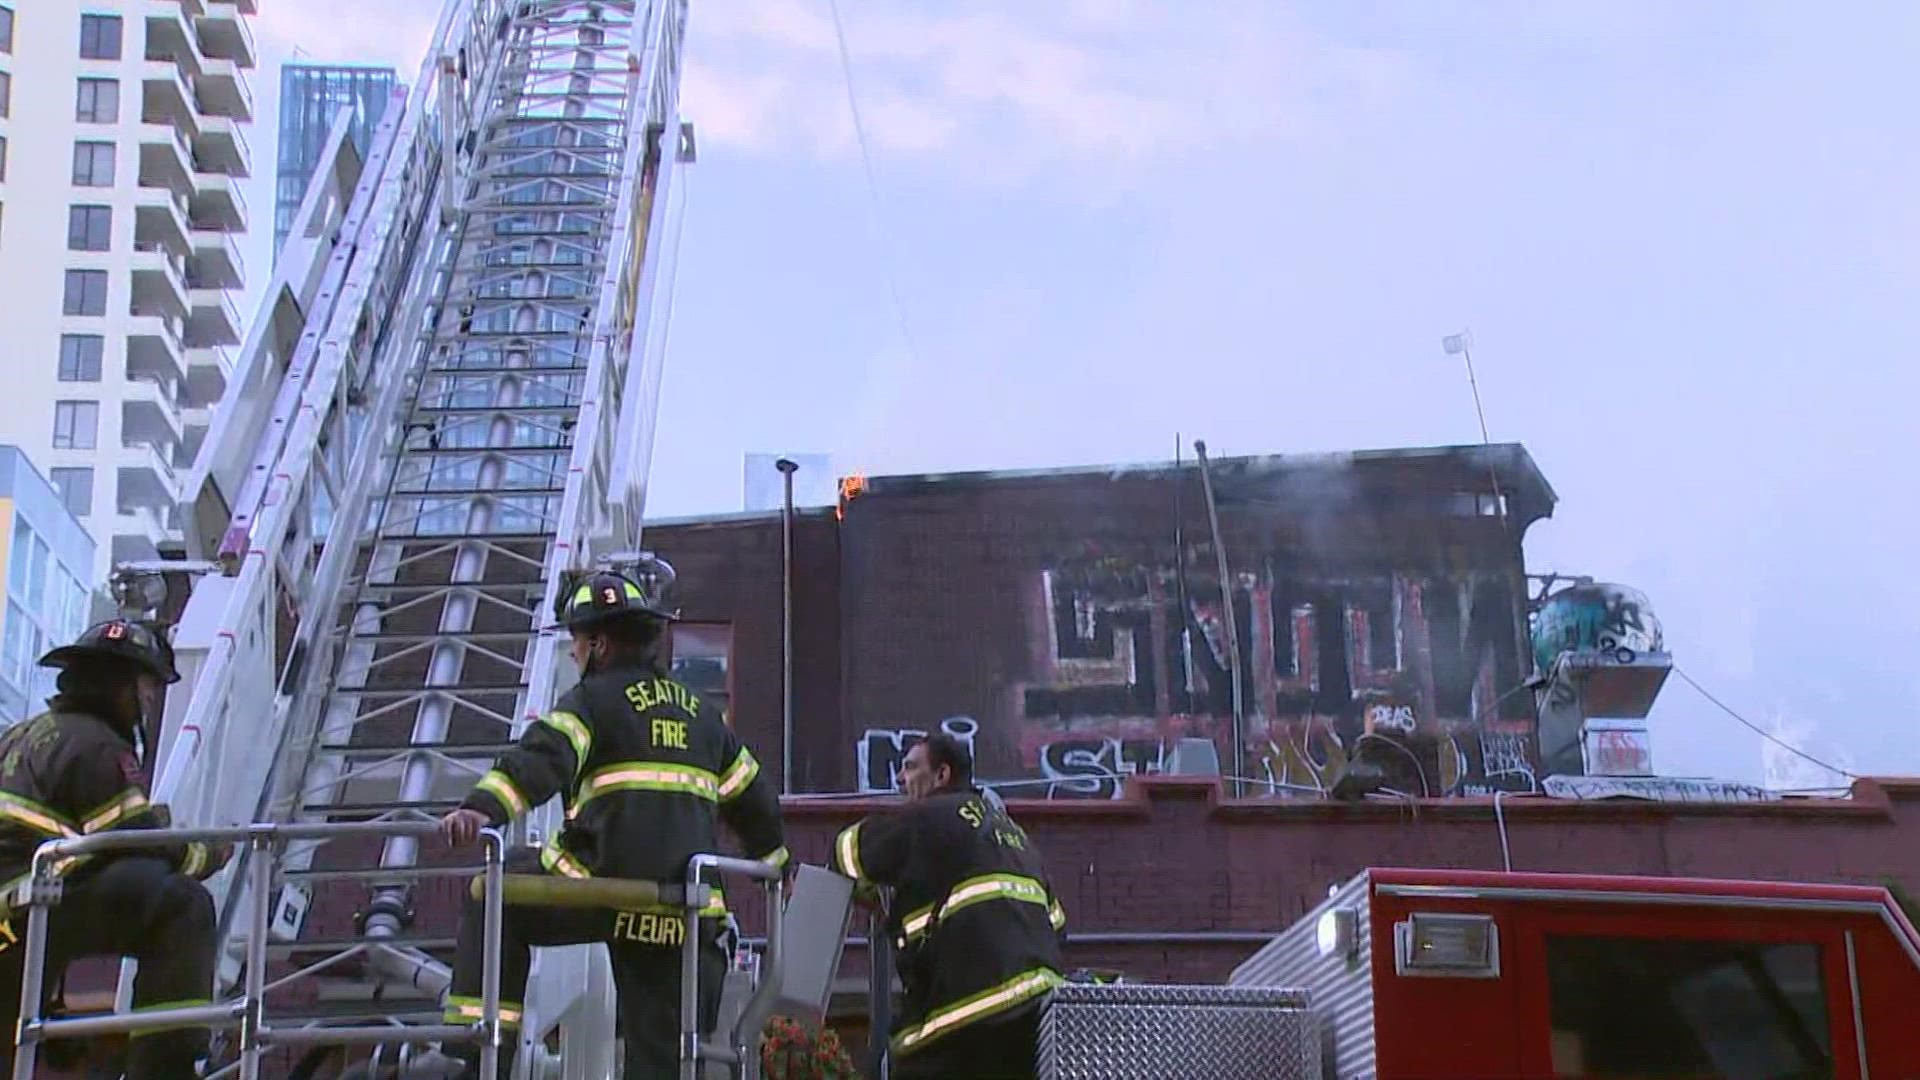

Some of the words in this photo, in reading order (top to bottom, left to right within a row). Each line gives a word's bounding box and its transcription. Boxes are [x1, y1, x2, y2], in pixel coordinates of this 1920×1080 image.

[603, 587, 617, 604] 3
[624, 677, 700, 718] SEATTLE
[651, 719, 688, 749] FIRE
[613, 911, 686, 946] FLEURY
